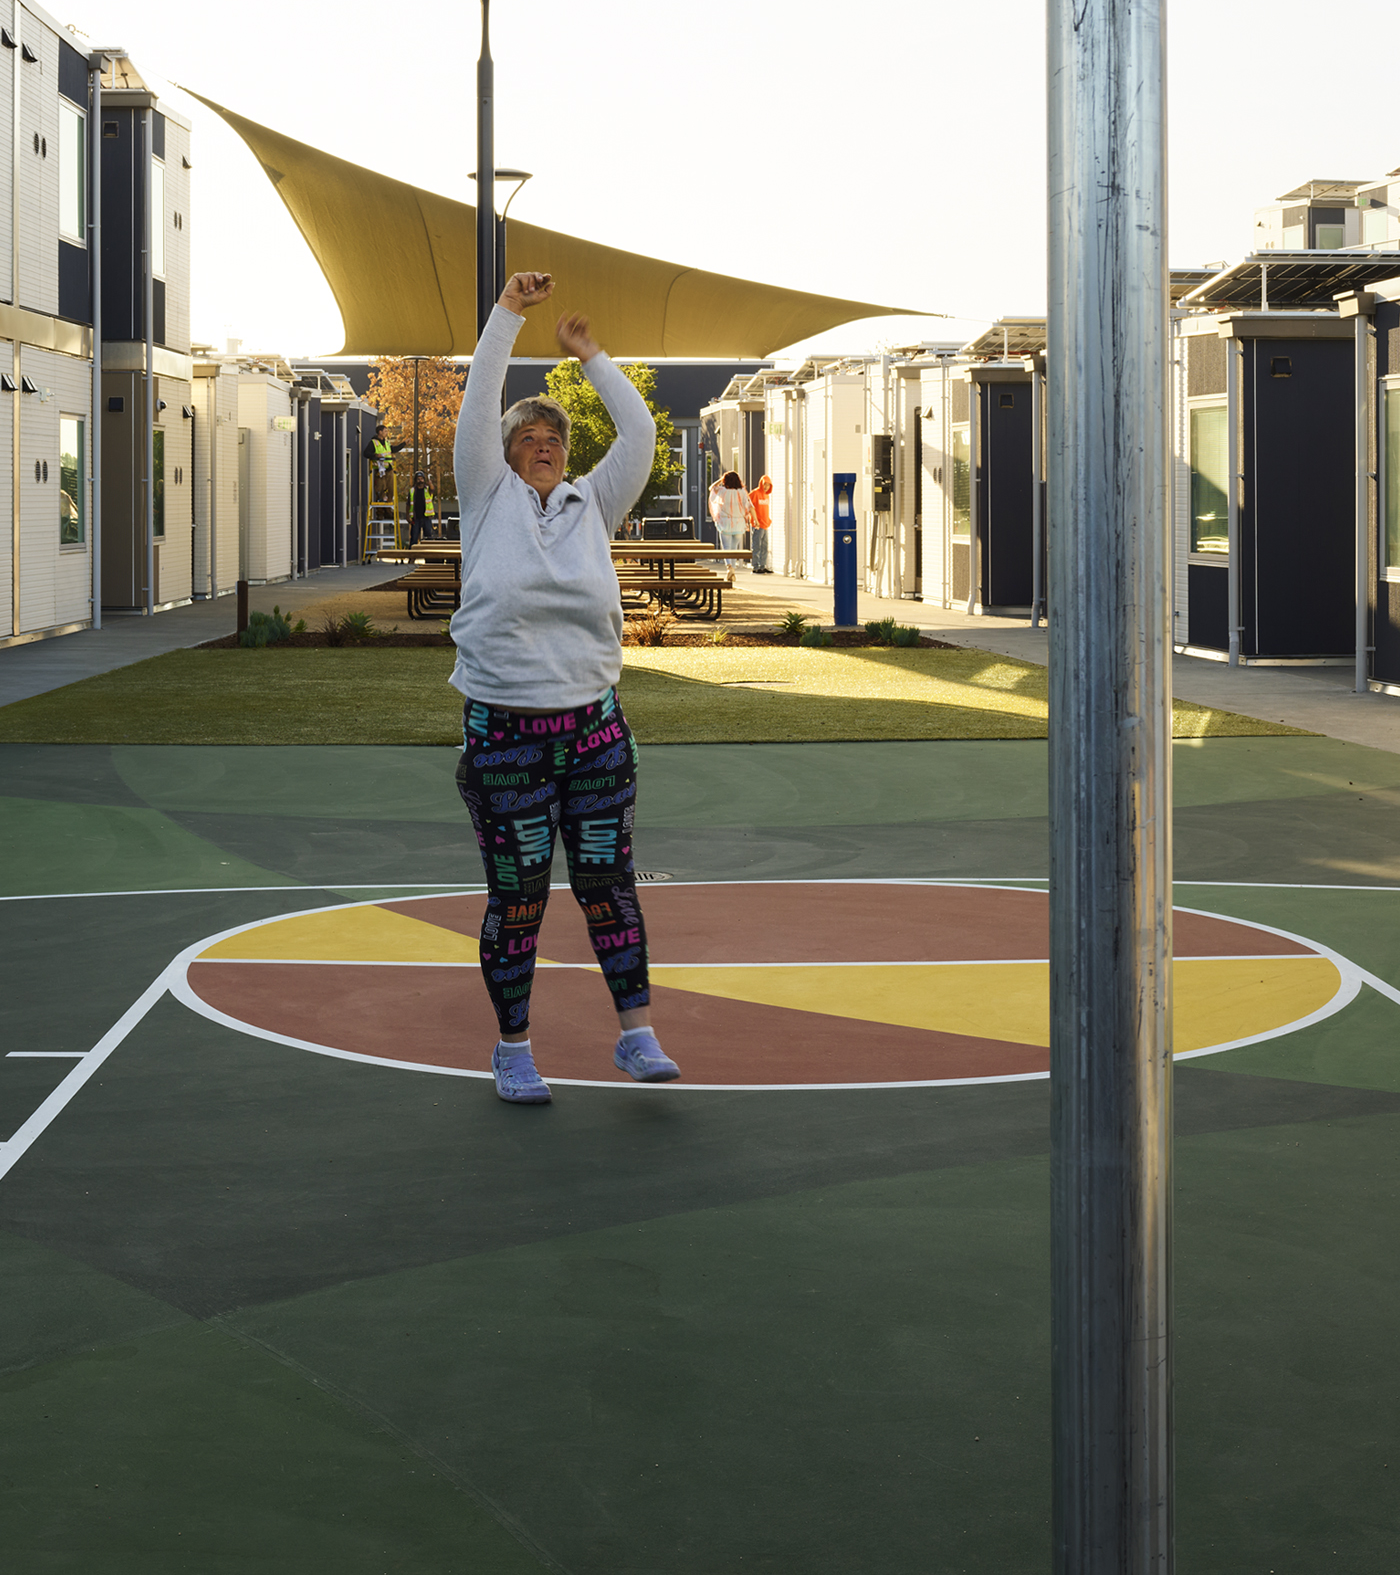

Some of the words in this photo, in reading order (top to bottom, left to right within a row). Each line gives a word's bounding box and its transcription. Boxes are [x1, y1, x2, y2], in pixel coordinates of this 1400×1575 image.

[519, 712, 576, 735] LOVE
[576, 722, 623, 754] LOVE
[483, 772, 530, 785] LOVE
[568, 775, 615, 791] LOVE
[513, 815, 551, 867] LOVE
[581, 818, 619, 864] LOVE
[493, 853, 520, 891] LOVE
[506, 900, 544, 922] LOVE
[483, 912, 501, 941] LOVE
